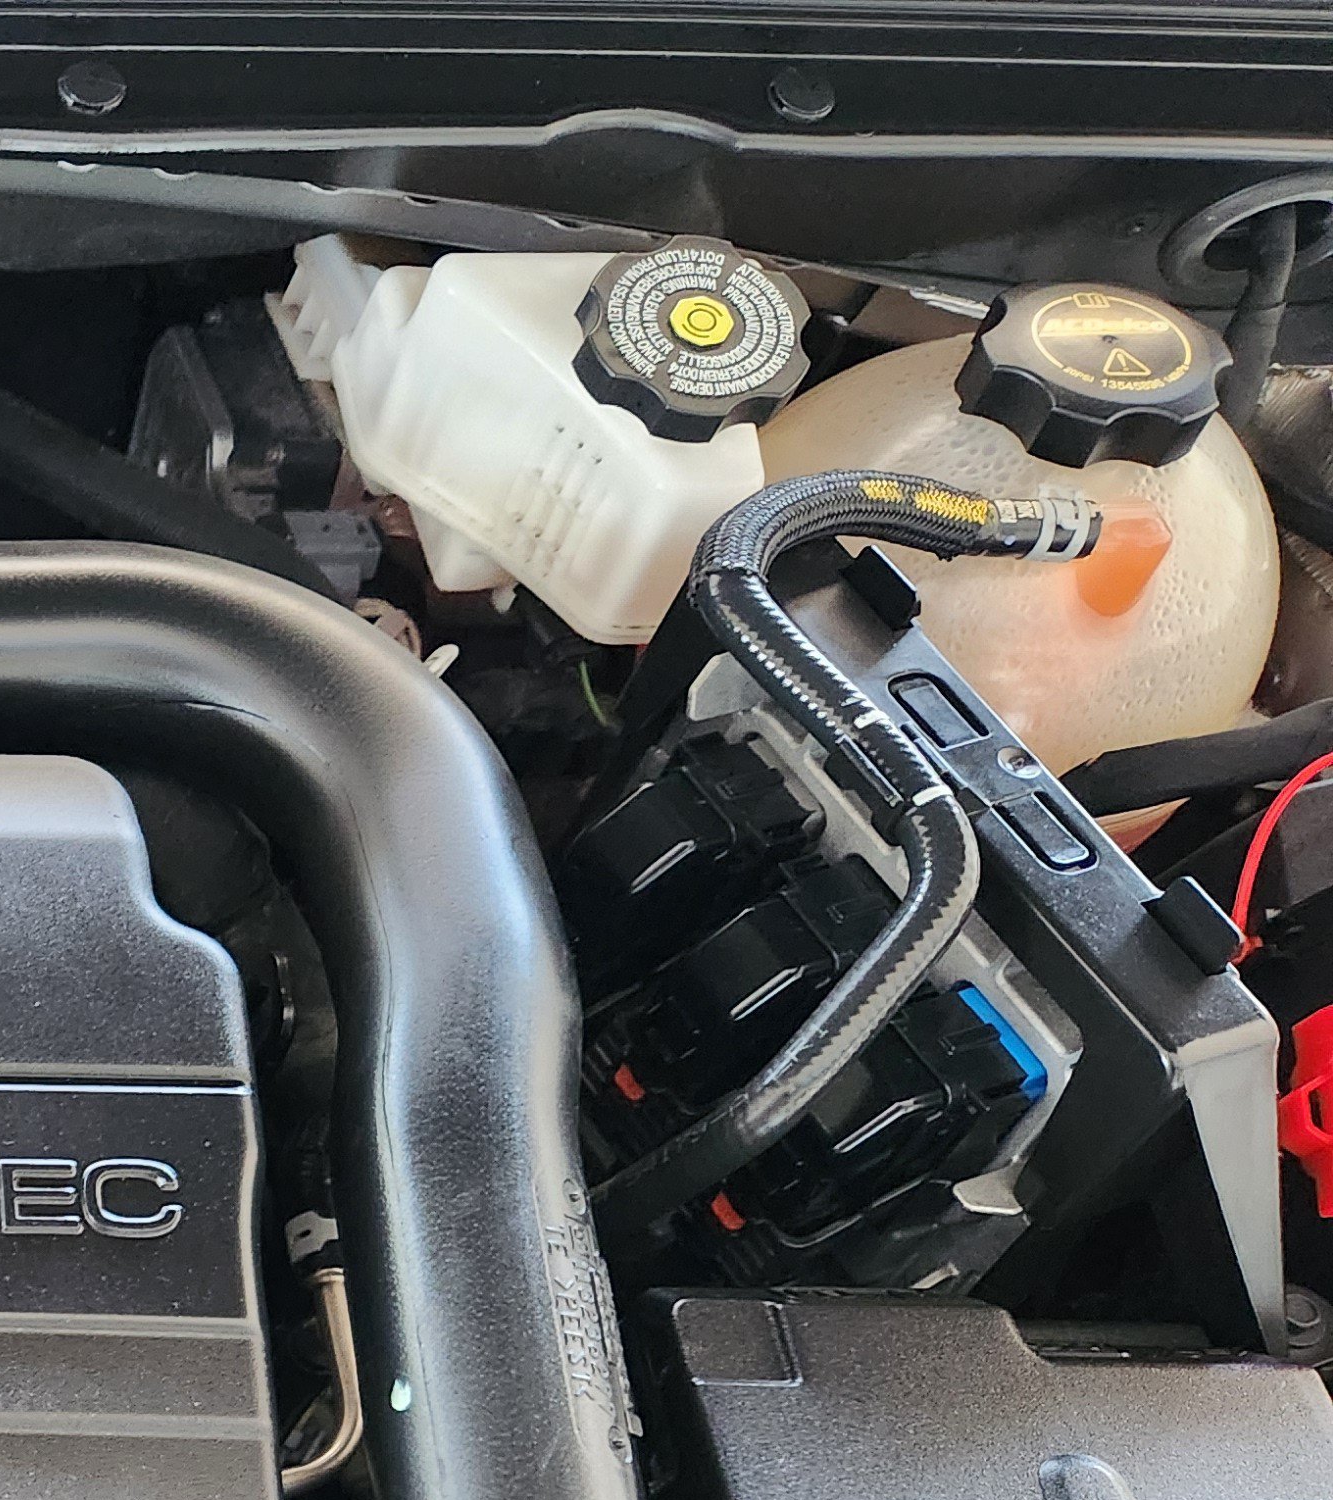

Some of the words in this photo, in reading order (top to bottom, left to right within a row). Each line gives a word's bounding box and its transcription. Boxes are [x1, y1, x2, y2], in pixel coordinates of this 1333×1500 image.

[695, 263, 721, 277] CAP
[642, 290, 665, 320] CLEAN
[643, 322, 673, 354] FILLER
[636, 339, 665, 366] ONLY
